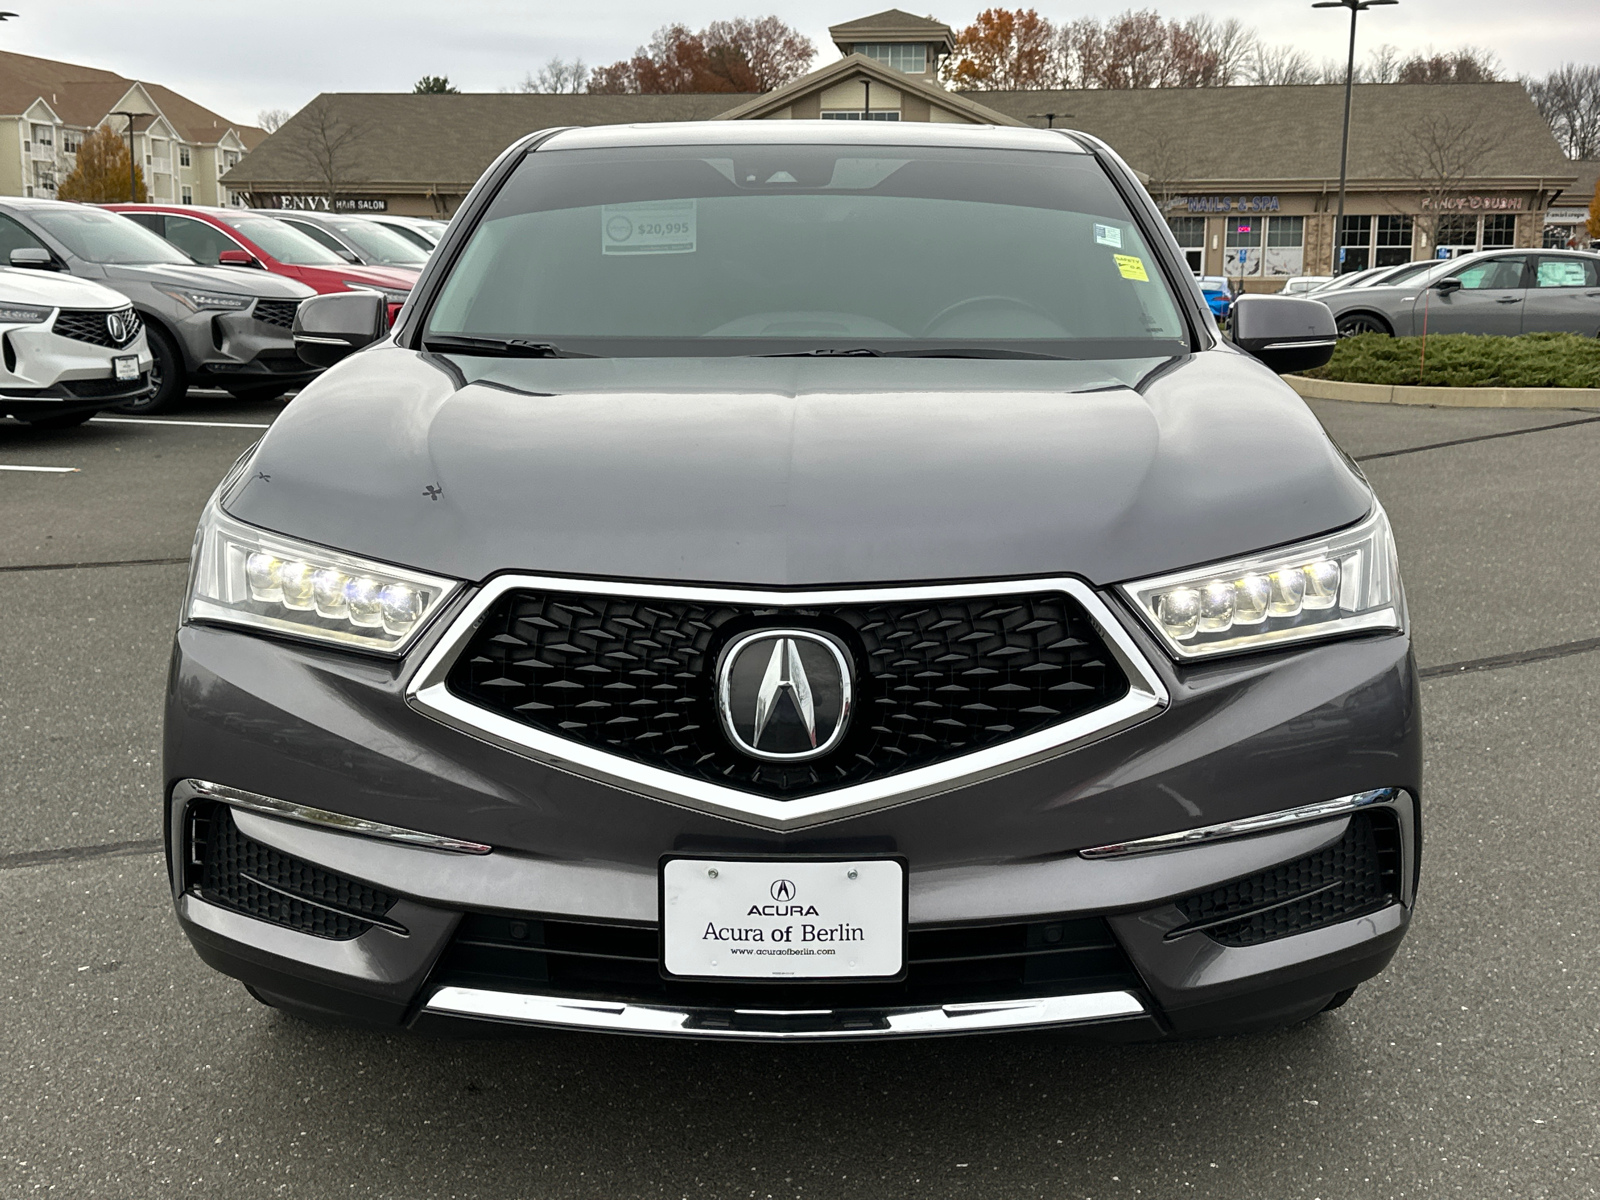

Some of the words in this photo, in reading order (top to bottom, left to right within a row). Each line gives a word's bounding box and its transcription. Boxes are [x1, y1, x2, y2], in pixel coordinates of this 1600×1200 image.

[281, 196, 331, 210] ENVY
[336, 200, 355, 209] HAIR
[358, 200, 385, 209] SALON
[1187, 197, 1232, 212] NAILS
[1237, 197, 1248, 212] &
[1251, 196, 1280, 212] SPA
[638, 222, 689, 236] $20,995
[747, 905, 819, 916] ACURA
[702, 922, 764, 942] Acura
[771, 926, 793, 942] of
[801, 923, 864, 942] Berlin
[730, 948, 836, 956] www.acuraofberlin.com
